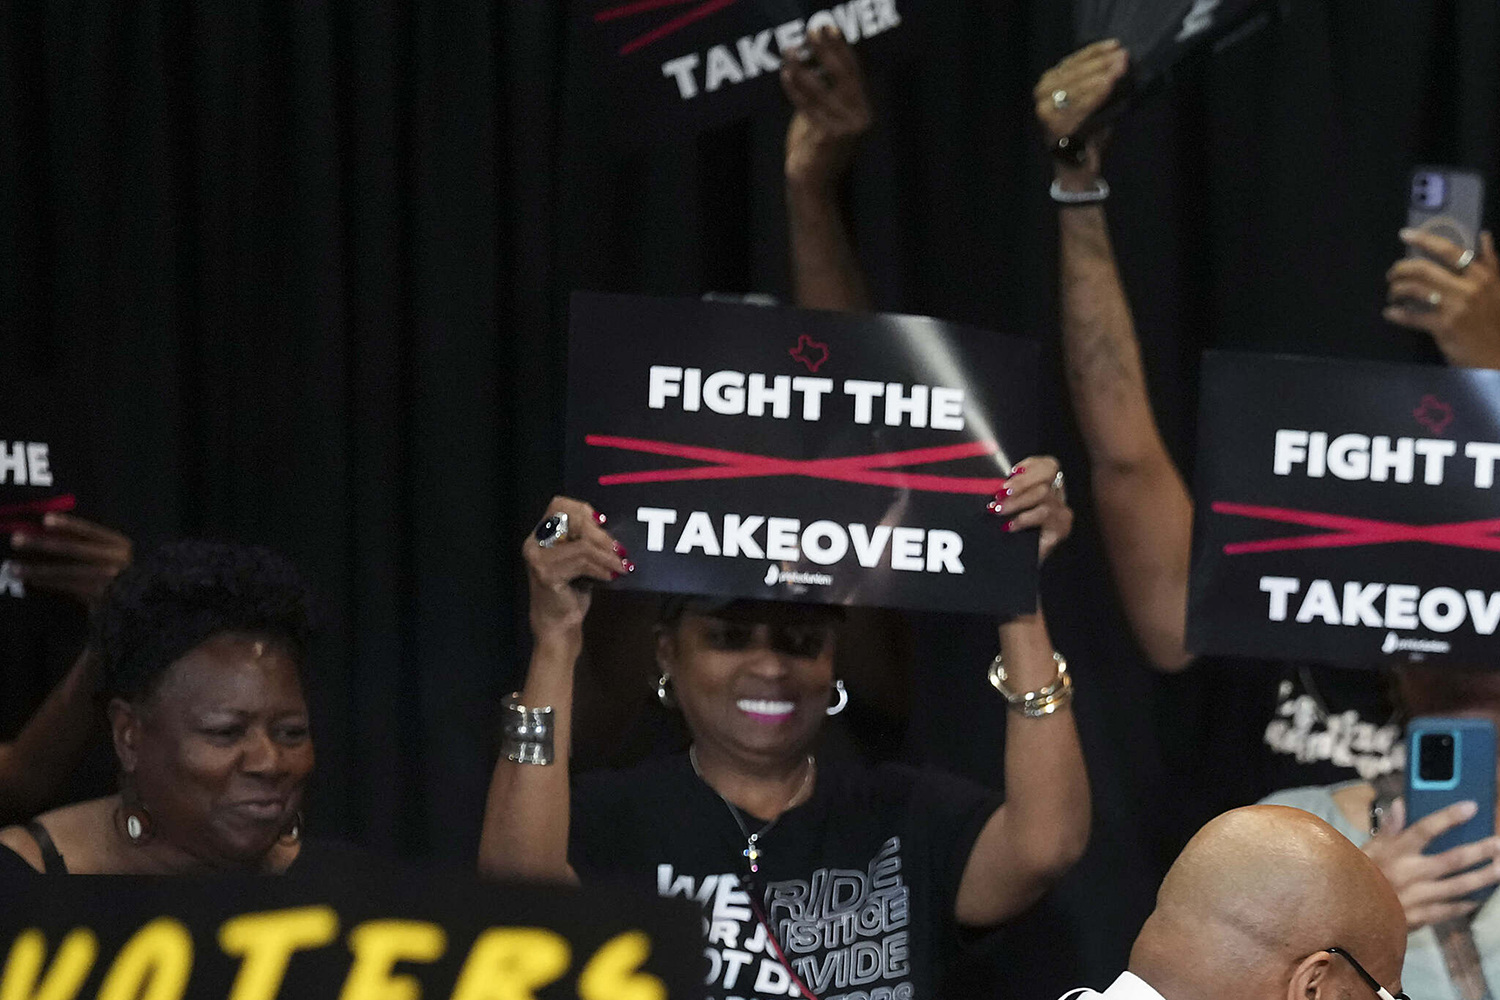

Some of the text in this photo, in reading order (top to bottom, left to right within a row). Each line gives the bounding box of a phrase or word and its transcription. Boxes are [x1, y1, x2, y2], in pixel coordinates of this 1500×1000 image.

[648, 365, 965, 431] FIGHT THE
[0, 440, 54, 487] HE
[1273, 429, 1457, 486] FIGHT
[636, 506, 966, 574] TAKEOVER
[657, 863, 751, 923] WE
[702, 947, 752, 991] OT
